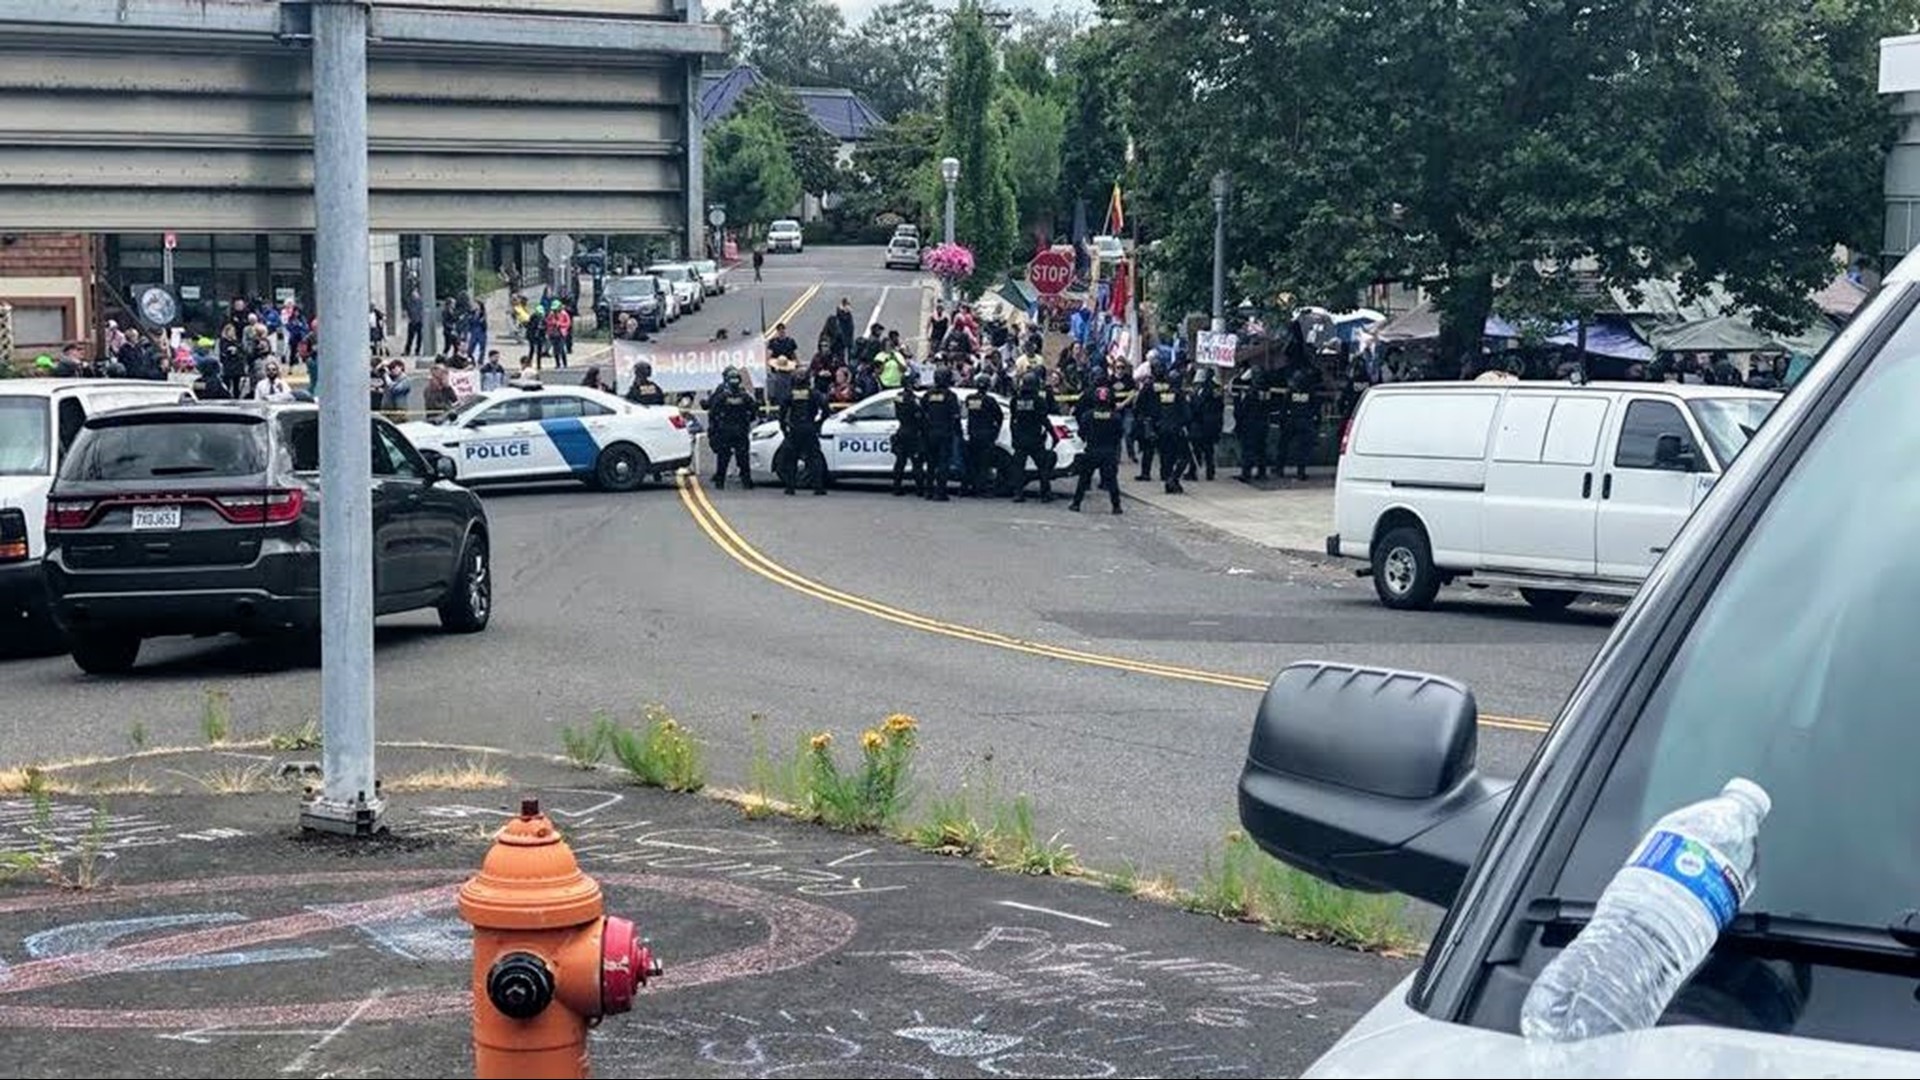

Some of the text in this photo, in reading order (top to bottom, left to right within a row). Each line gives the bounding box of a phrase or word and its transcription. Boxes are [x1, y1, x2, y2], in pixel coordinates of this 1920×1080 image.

[1032, 265, 1069, 282] STOP
[465, 443, 531, 459] POLICE
[839, 440, 890, 453] POLIC
